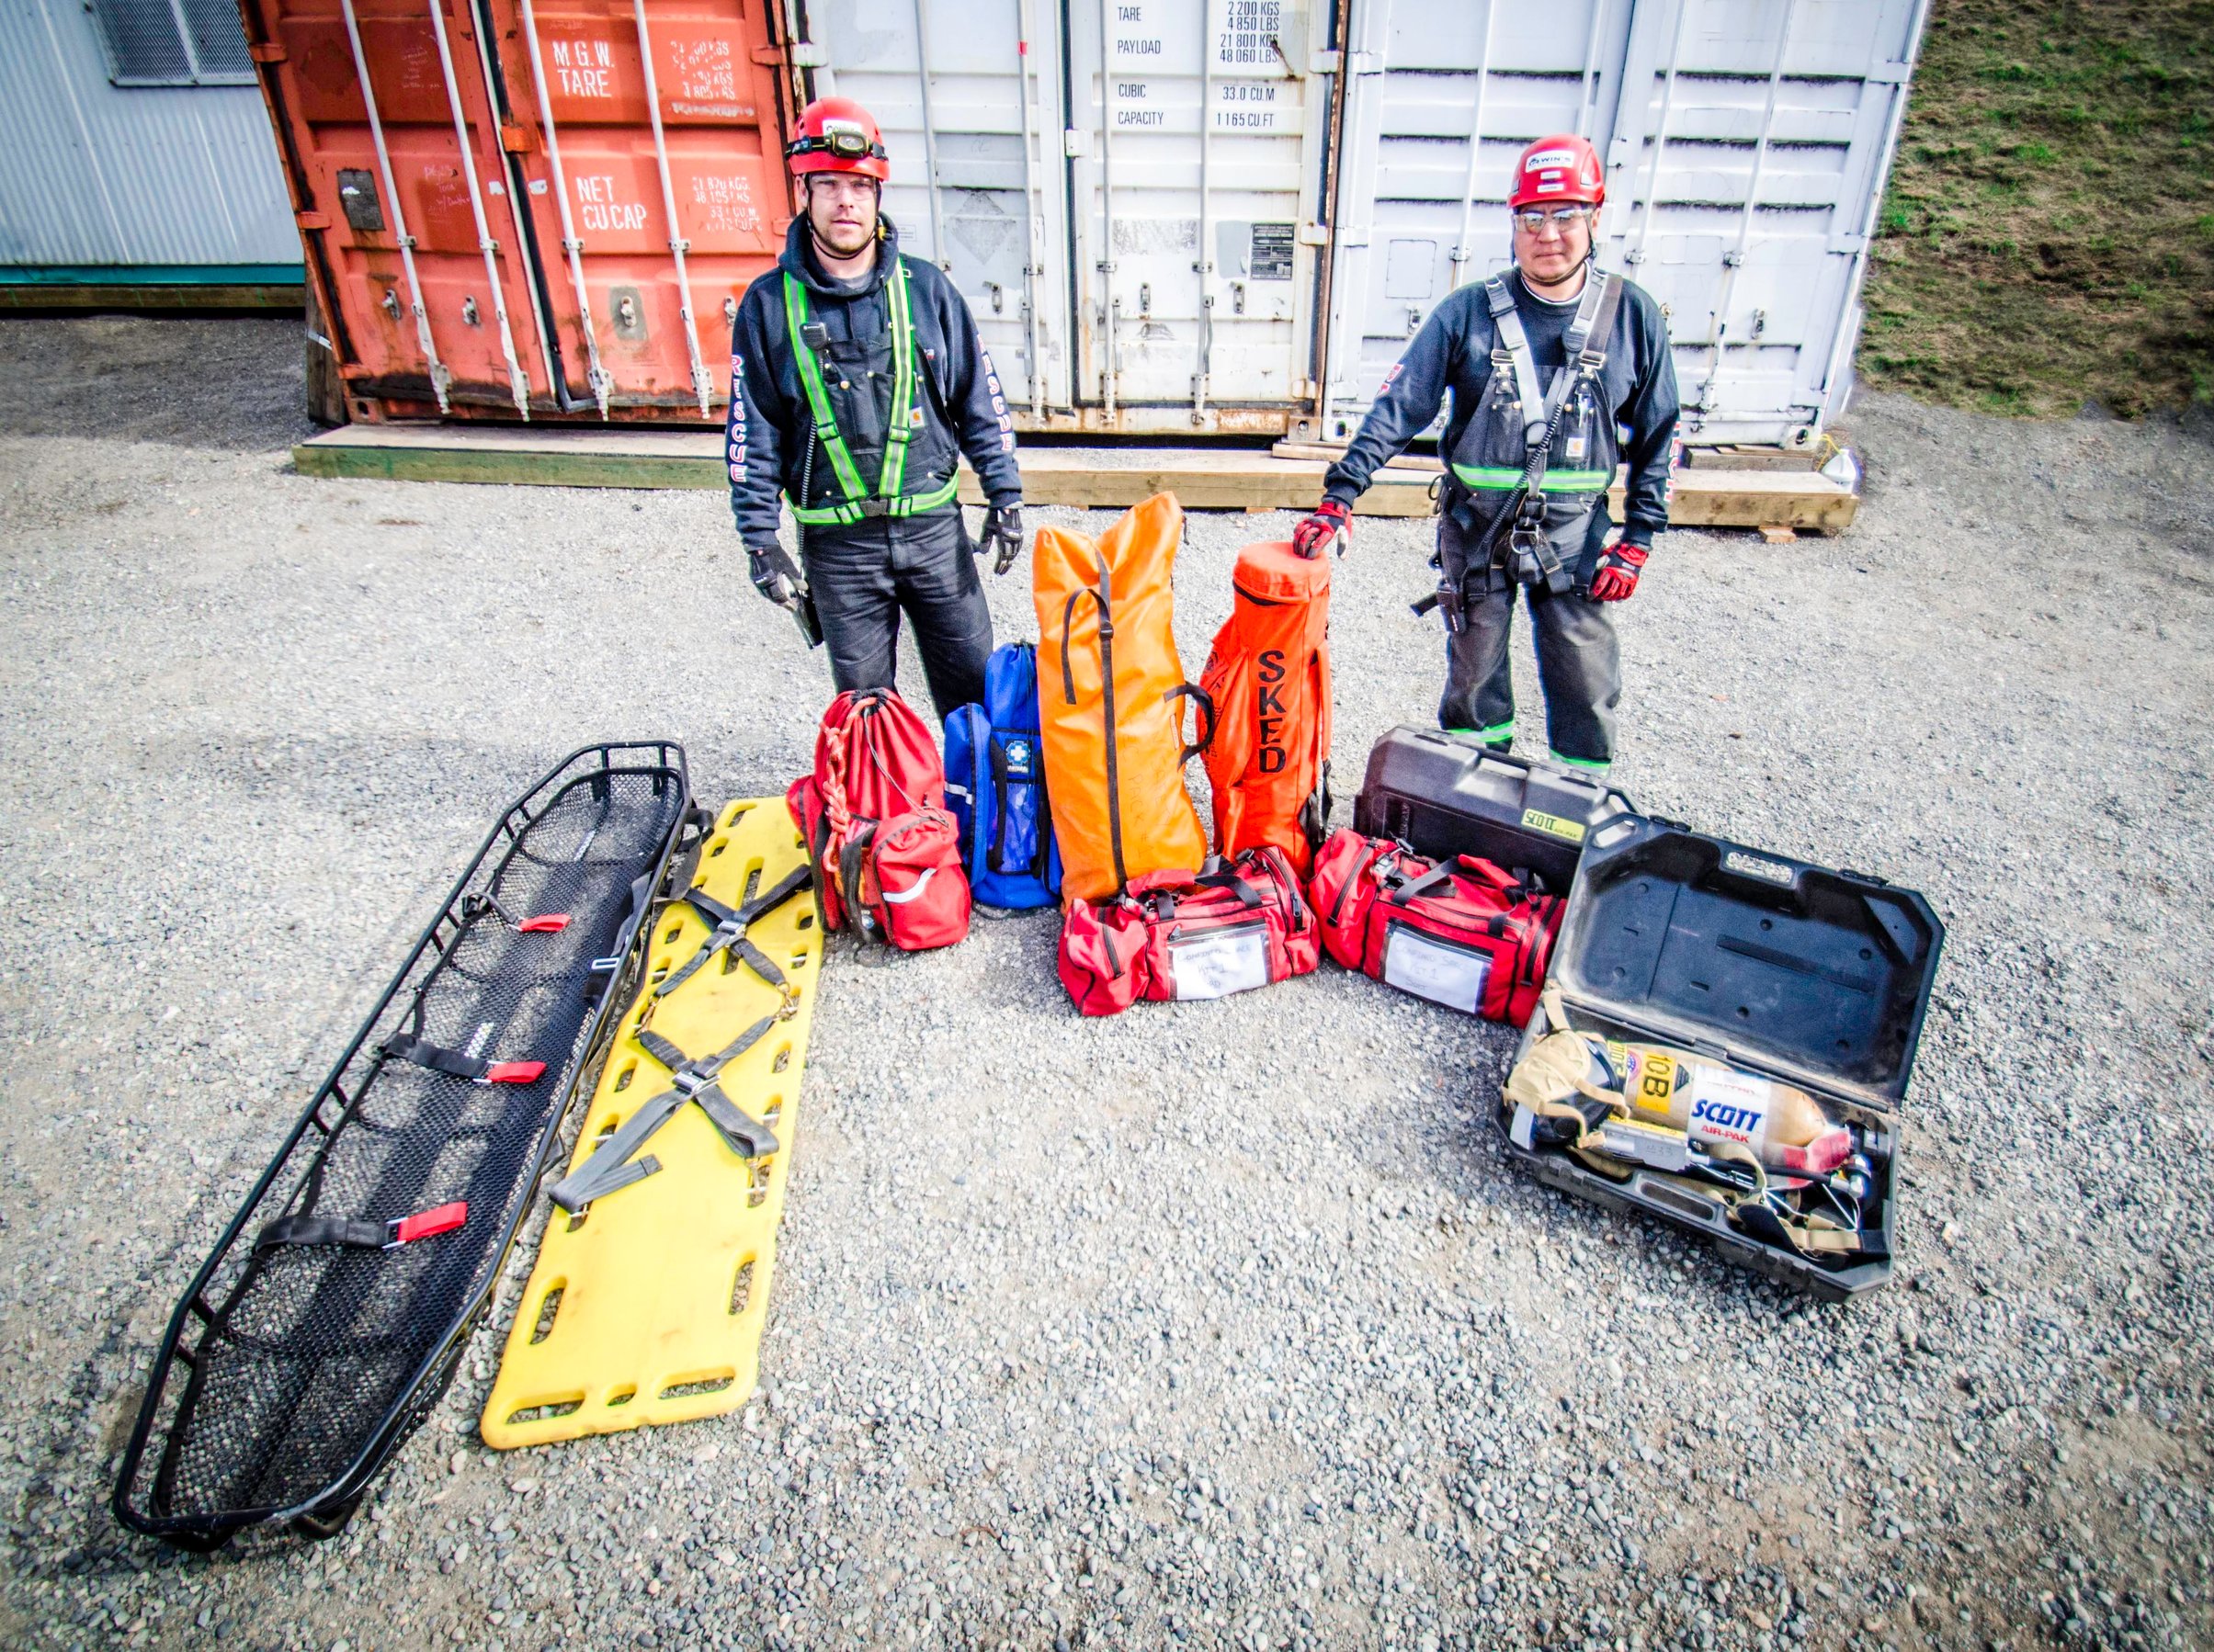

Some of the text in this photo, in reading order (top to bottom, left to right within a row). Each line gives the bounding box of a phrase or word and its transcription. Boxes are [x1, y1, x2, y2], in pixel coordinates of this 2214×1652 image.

[1118, 6, 1141, 21] TARE
[1228, 1, 1279, 16] 2 200 KGS
[1227, 17, 1279, 31] 4 850 LBS
[1118, 40, 1162, 54] PAYLOAD
[1220, 33, 1232, 48] 21
[1236, 33, 1256, 48] 800
[1220, 49, 1278, 63] 48 060 LBS
[557, 69, 612, 97] TARE
[1118, 83, 1146, 98] CUBIC
[1222, 86, 1246, 101] 33.0
[1118, 111, 1164, 126] CAPACITY
[575, 175, 614, 203] NET
[1257, 650, 1287, 774] SKED
[1525, 811, 1557, 831] SCOTT
[1642, 1054, 1672, 1098] 10B
[1691, 1098, 1762, 1133] SCOTT
[1701, 1125, 1751, 1144] AIR-PAK
